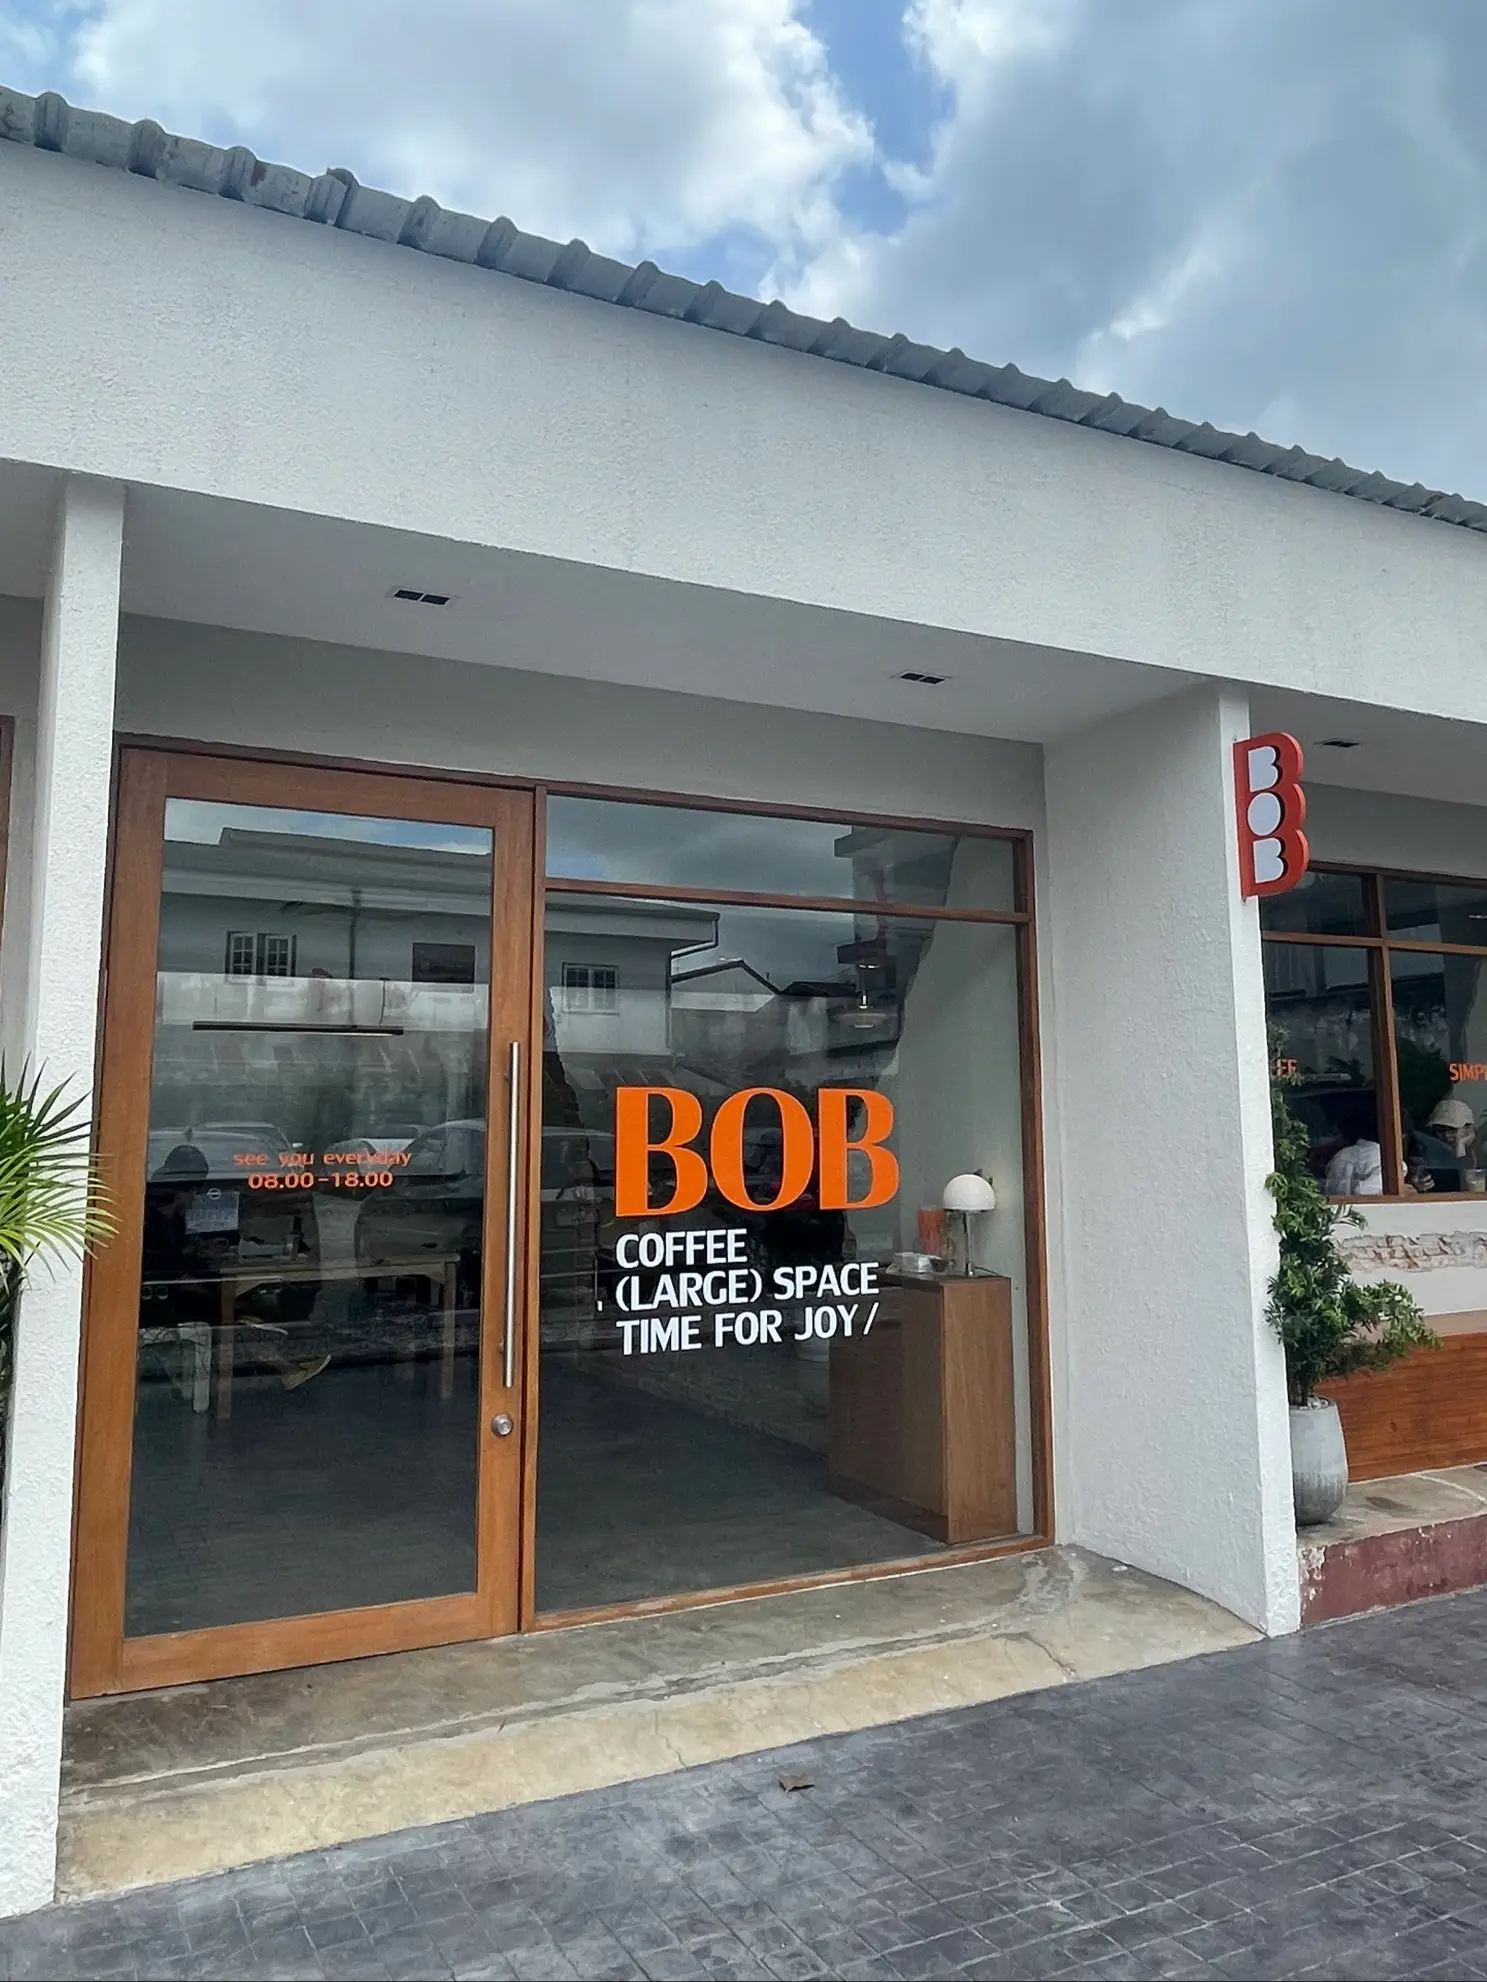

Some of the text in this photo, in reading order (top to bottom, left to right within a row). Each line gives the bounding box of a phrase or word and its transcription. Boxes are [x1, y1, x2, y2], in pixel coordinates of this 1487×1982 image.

[1245, 743, 1287, 886] BOB
[1449, 1063, 1487, 1081] SIMP
[232, 1149, 412, 1168] see you everyday
[615, 1086, 900, 1218] BOB
[616, 1228, 748, 1269] COFFEE
[615, 1262, 880, 1312] (LARGE) SPACE
[616, 1315, 702, 1356] TIME
[714, 1310, 783, 1348] FOR
